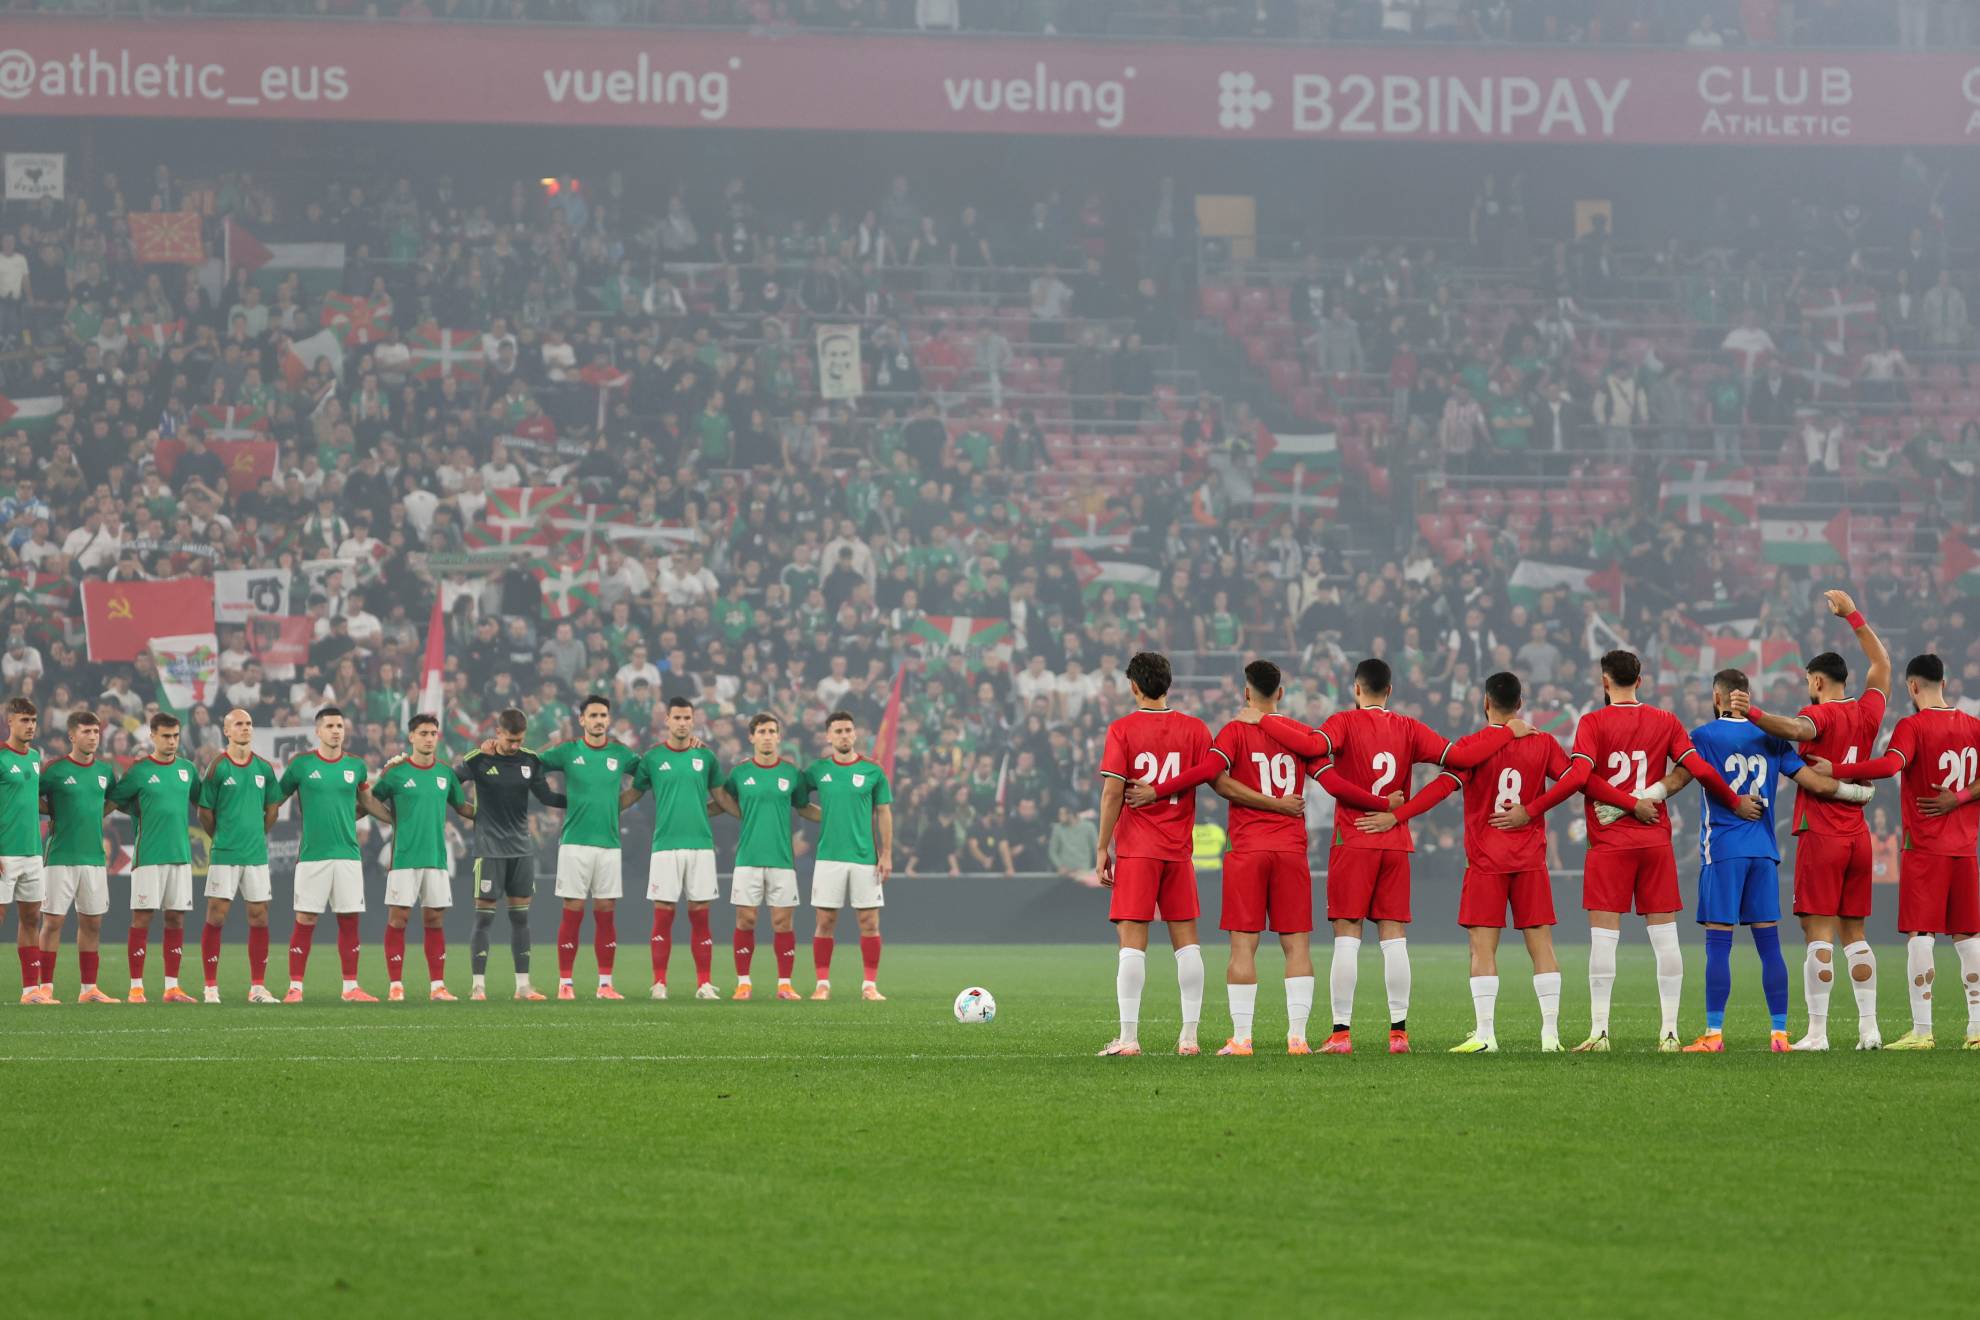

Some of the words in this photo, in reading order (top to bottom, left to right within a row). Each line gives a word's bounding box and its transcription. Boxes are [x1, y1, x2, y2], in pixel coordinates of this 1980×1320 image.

[0, 48, 349, 105] @athletic_eus
[543, 51, 729, 120] vueling
[943, 61, 1125, 129] vueling
[1698, 65, 1853, 105] CLUB
[1292, 73, 1632, 135] B2BINPAY
[1701, 108, 1851, 136] ATHLETIC
[1134, 751, 1181, 805] 24
[1251, 752, 1296, 799] 19
[1371, 751, 1397, 799] 2
[1494, 767, 1522, 813] 8
[1607, 750, 1648, 791] 21
[1724, 752, 1769, 808] 22
[1938, 745, 1978, 792] 20
